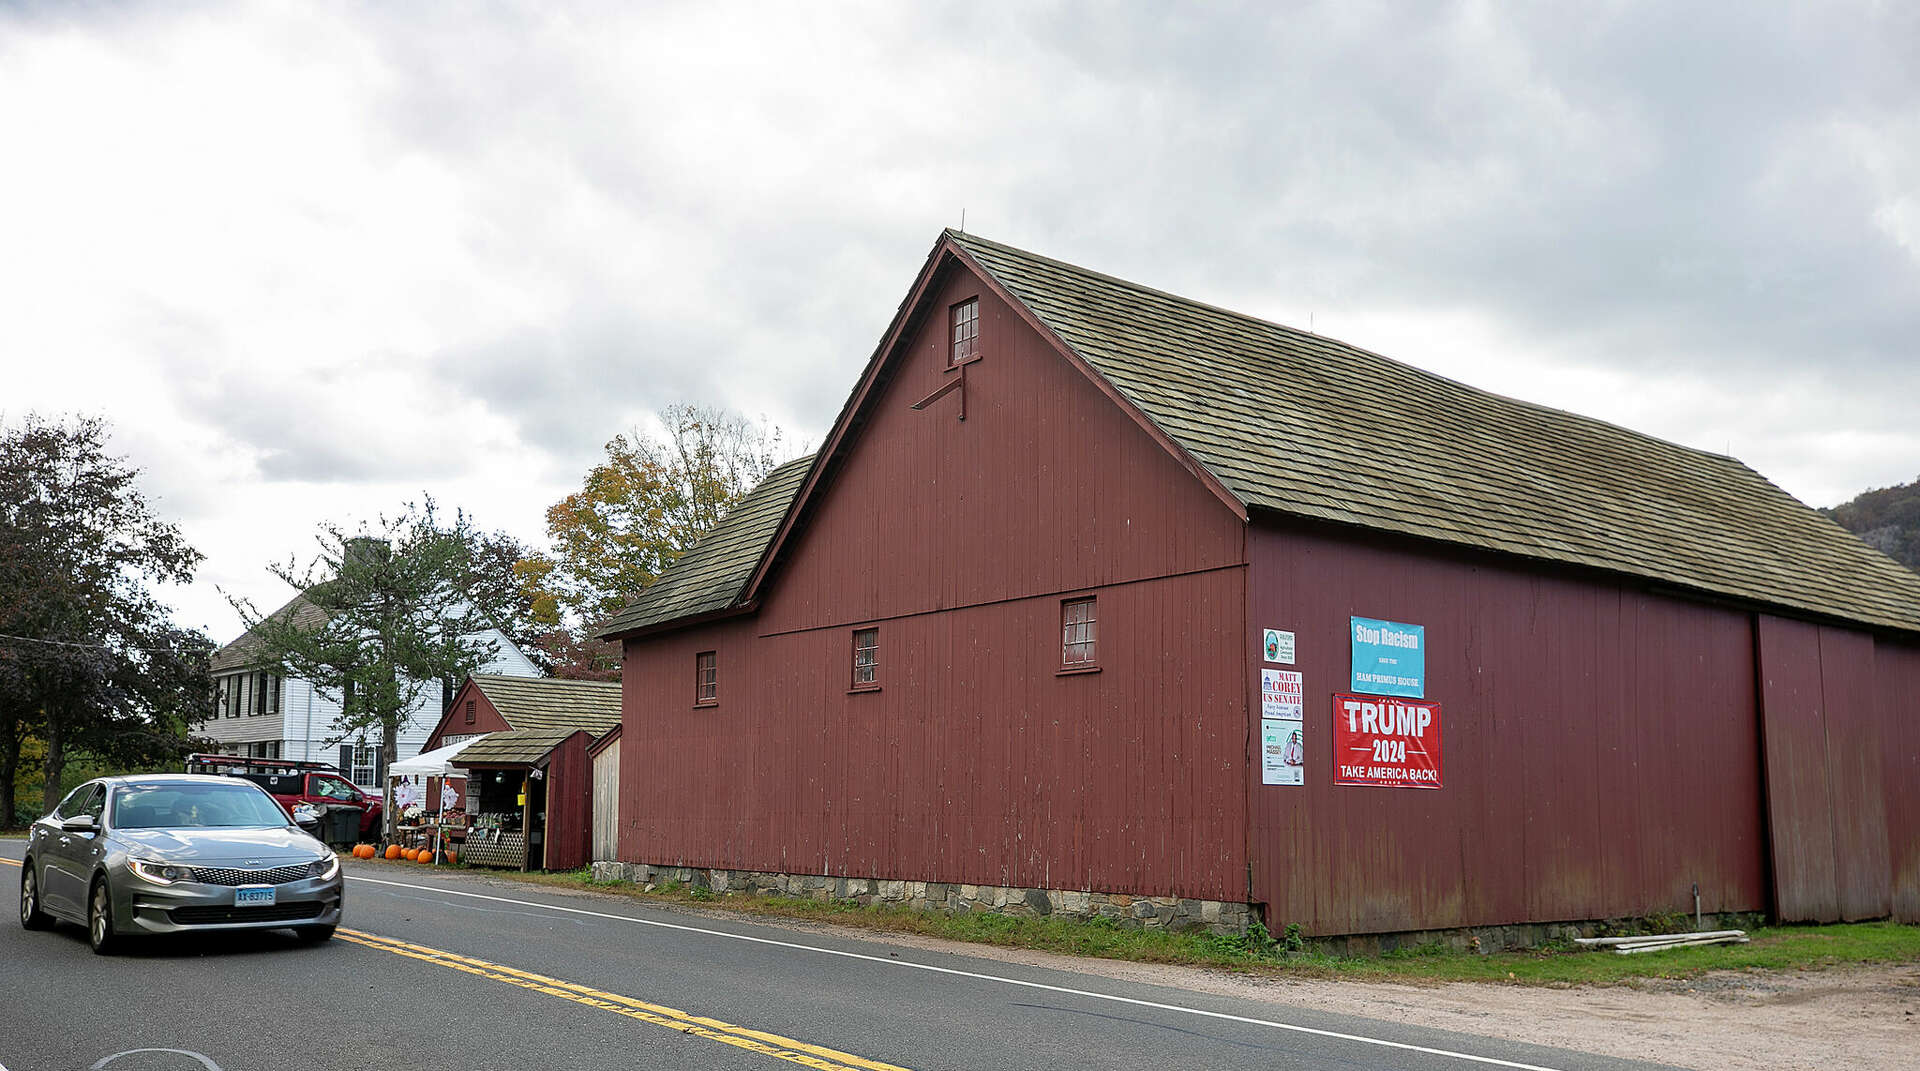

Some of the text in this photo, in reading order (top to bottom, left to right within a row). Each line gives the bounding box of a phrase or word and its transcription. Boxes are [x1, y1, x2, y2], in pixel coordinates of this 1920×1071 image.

[1356, 624, 1418, 649] Stop Racism
[1279, 672, 1297, 682] MATT
[1356, 672, 1372, 683] HAM
[1397, 676, 1419, 687] HOUSE
[1272, 680, 1301, 694] COREY
[1263, 692, 1302, 705] US SENATE
[1343, 701, 1432, 737] TRUMP
[1373, 739, 1406, 763] 2024
[1340, 765, 1437, 781] TAKE AMERICA BACK!
